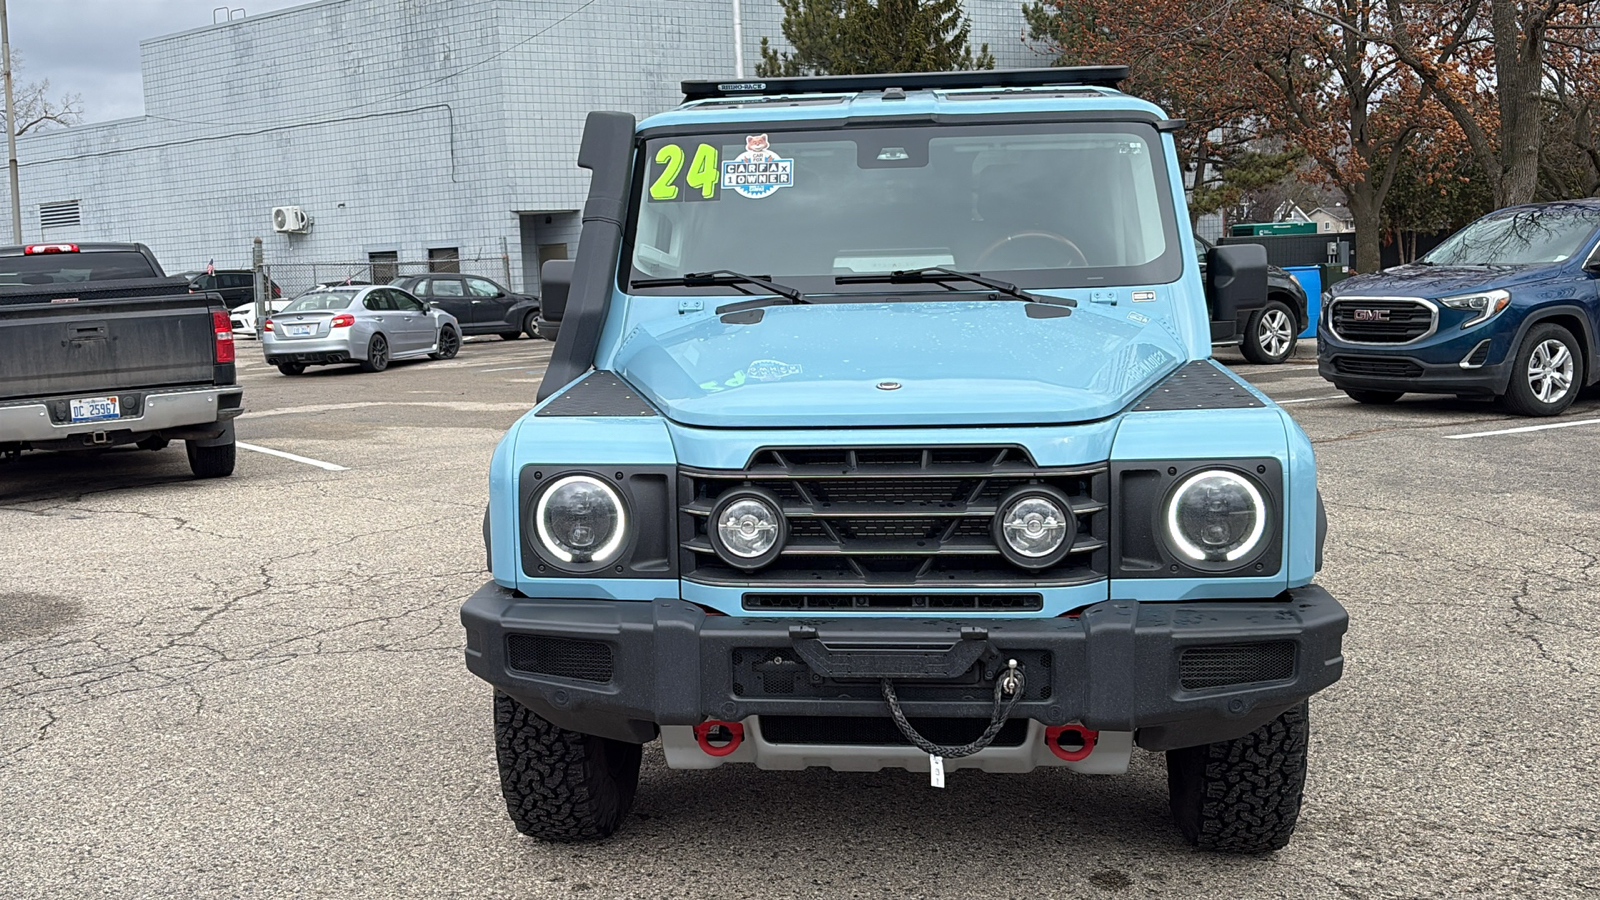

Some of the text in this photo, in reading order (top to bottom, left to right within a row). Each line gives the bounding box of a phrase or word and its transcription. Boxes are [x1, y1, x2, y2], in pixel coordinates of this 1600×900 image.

[650, 143, 719, 200] 24
[727, 163, 788, 173] CARFAX
[1354, 309, 1390, 321] GMC
[73, 403, 116, 417] DC 25967
